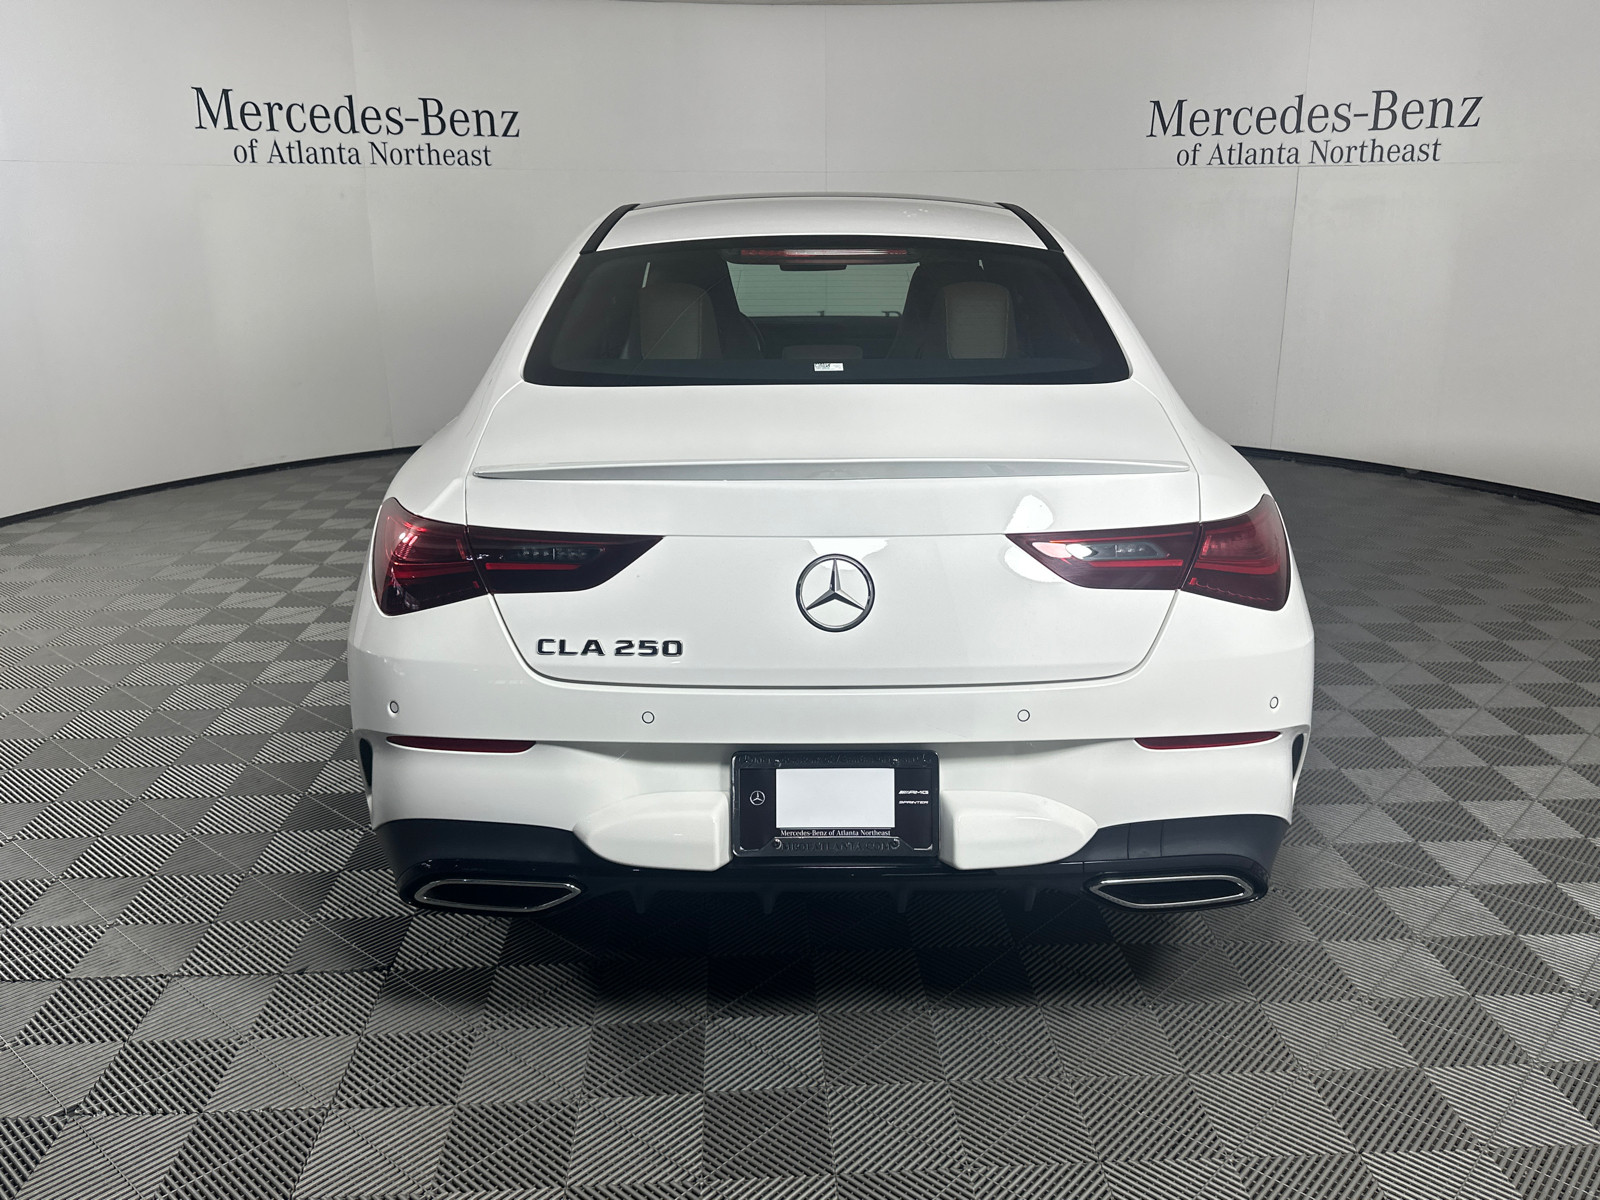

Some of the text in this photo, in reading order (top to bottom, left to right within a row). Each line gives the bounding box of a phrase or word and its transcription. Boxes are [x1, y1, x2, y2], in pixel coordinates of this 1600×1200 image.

[191, 86, 521, 138] Mercedes-Benz
[1146, 89, 1484, 138] Mercedes-Benz
[233, 138, 492, 167] of Atlanta Northeast
[1176, 138, 1442, 167] of Atlanta Northeast
[537, 638, 684, 658] CLA 250
[780, 829, 891, 837] Mercedes-Benz of Atlanta Northeast
